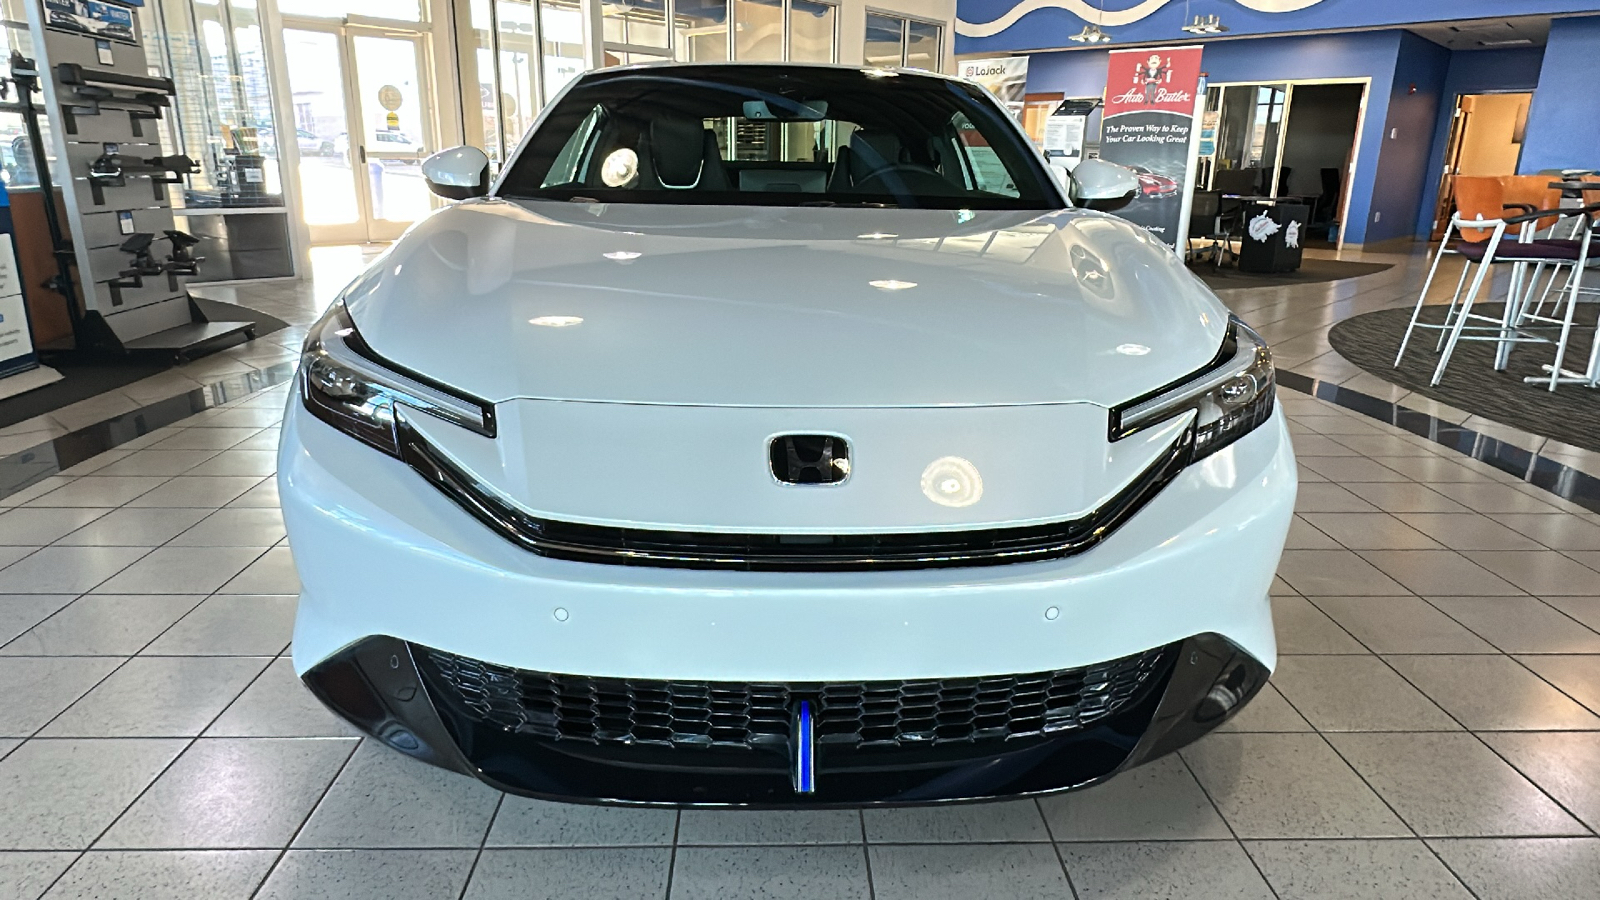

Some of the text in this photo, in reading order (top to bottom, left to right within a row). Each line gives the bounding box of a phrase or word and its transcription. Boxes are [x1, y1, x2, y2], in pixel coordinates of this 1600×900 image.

[1112, 87, 1190, 104] Auto Butler
[1106, 124, 1189, 135] The Proven Way to Keep
[1105, 134, 1188, 144] Your Car Looking Great
